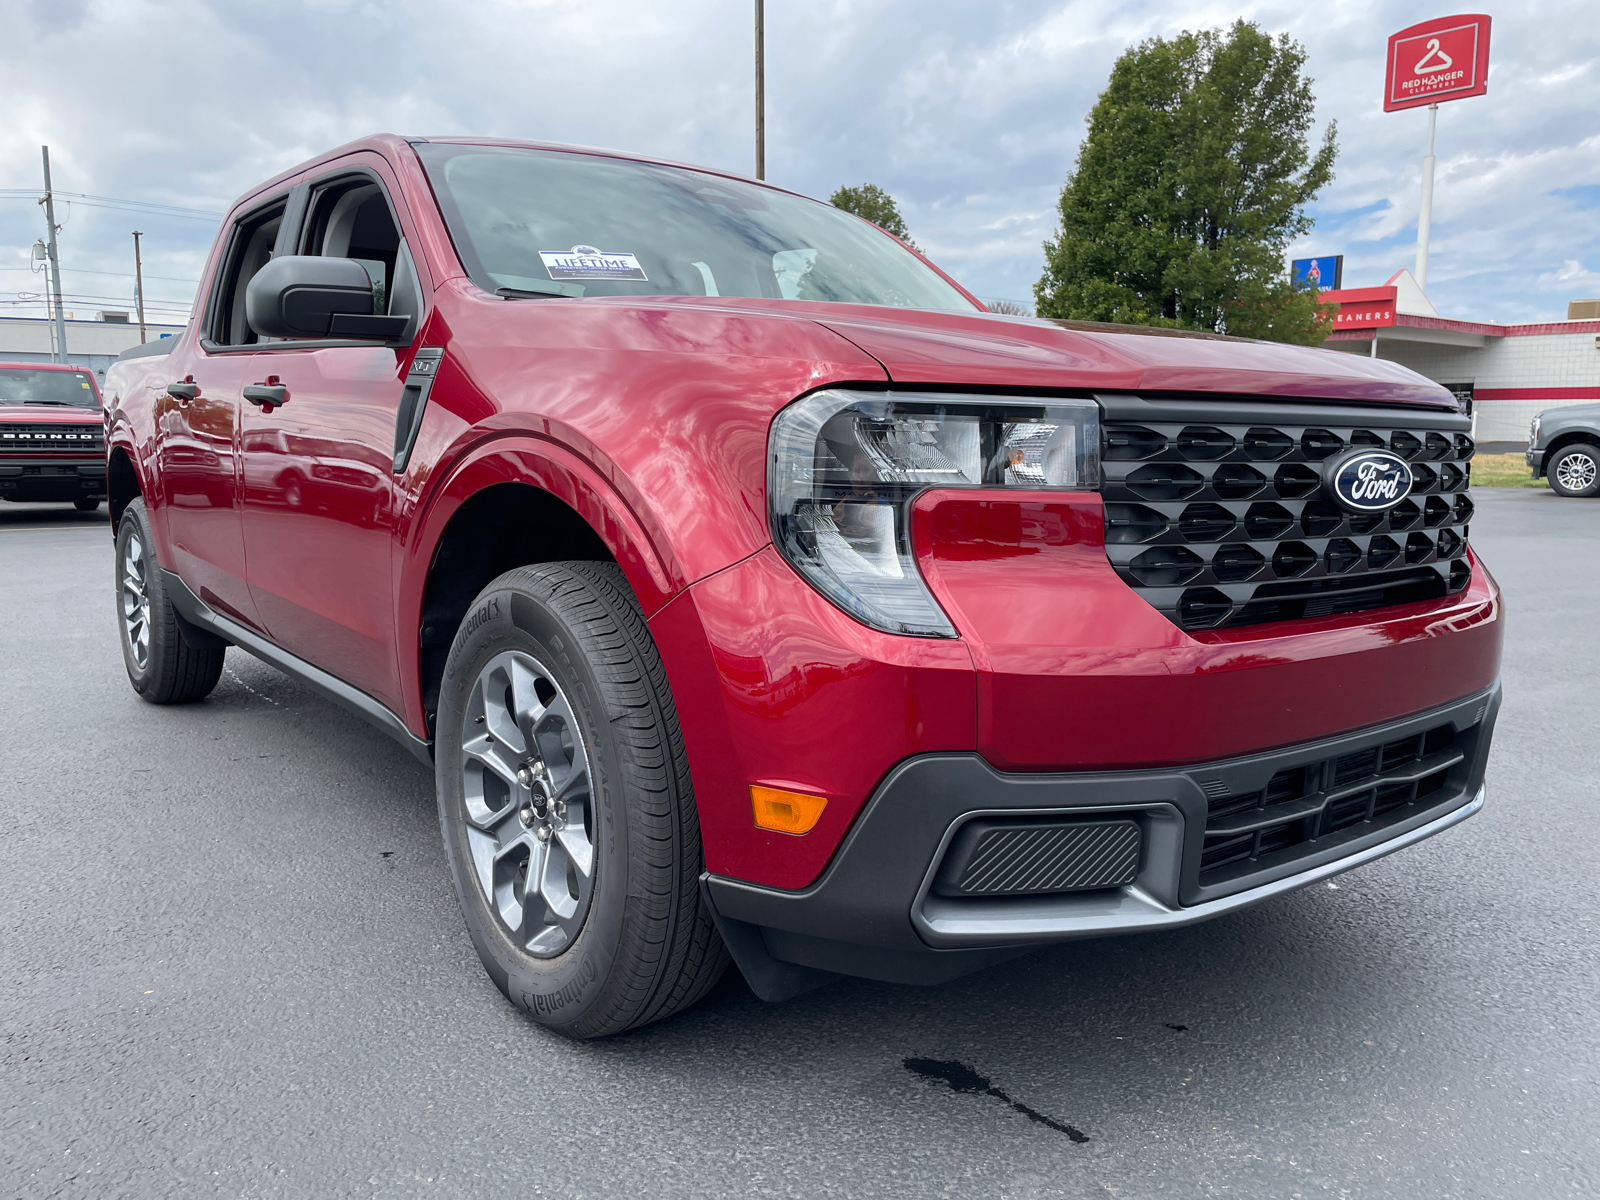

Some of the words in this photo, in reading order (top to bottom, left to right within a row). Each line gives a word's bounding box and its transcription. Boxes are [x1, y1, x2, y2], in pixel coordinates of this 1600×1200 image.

[1402, 79, 1420, 89] RED
[1422, 70, 1464, 85] HANGER
[1409, 81, 1455, 94] CLEANERS
[555, 259, 629, 268] LIFETIME
[1321, 311, 1391, 323] EANERS
[1351, 461, 1401, 500] Ford
[834, 491, 908, 499] MAVERIK
[445, 599, 492, 680] Continental
[531, 952, 599, 1016] Continental
